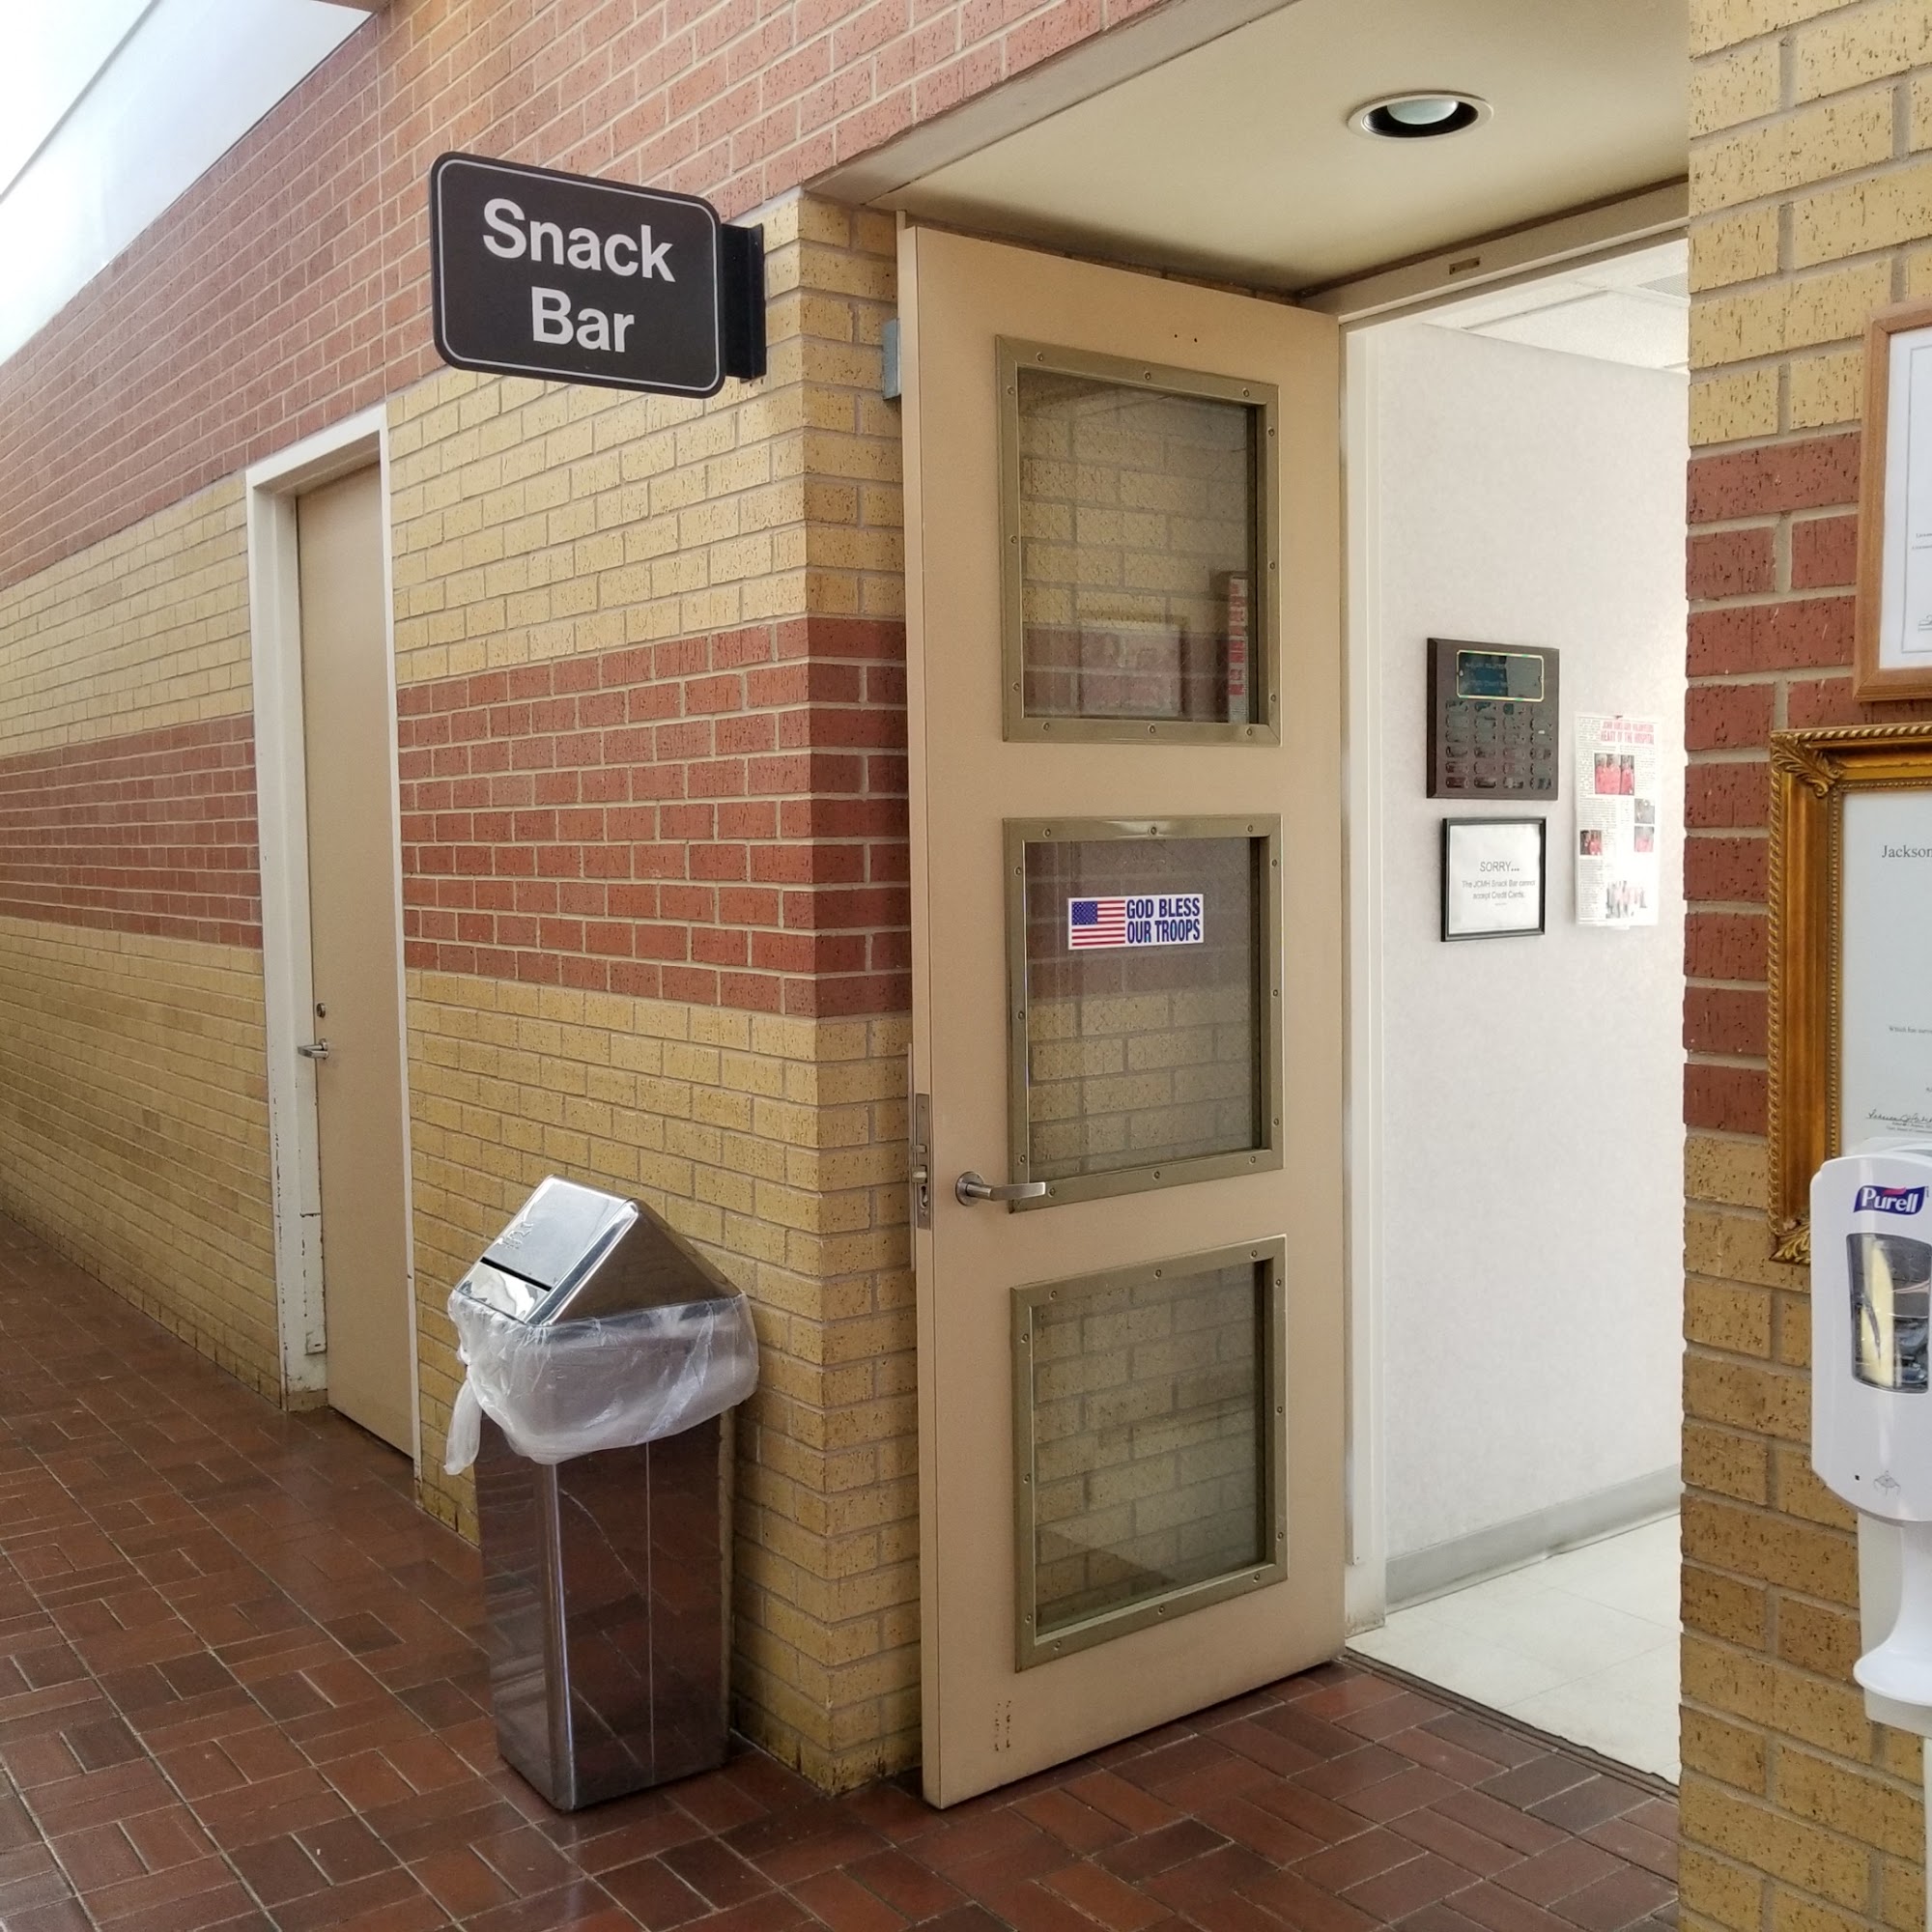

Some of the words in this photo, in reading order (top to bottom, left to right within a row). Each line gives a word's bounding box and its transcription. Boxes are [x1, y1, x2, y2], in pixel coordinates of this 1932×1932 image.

[483, 198, 675, 282] Snack
[531, 286, 635, 353] Bar
[1492, 879, 1508, 888] Snack
[1126, 898, 1154, 919] GOD
[1159, 897, 1200, 918] BLESS
[1127, 921, 1151, 944] OUR
[1154, 919, 1201, 943] TROOPS
[1861, 1187, 1918, 1212] Purell
